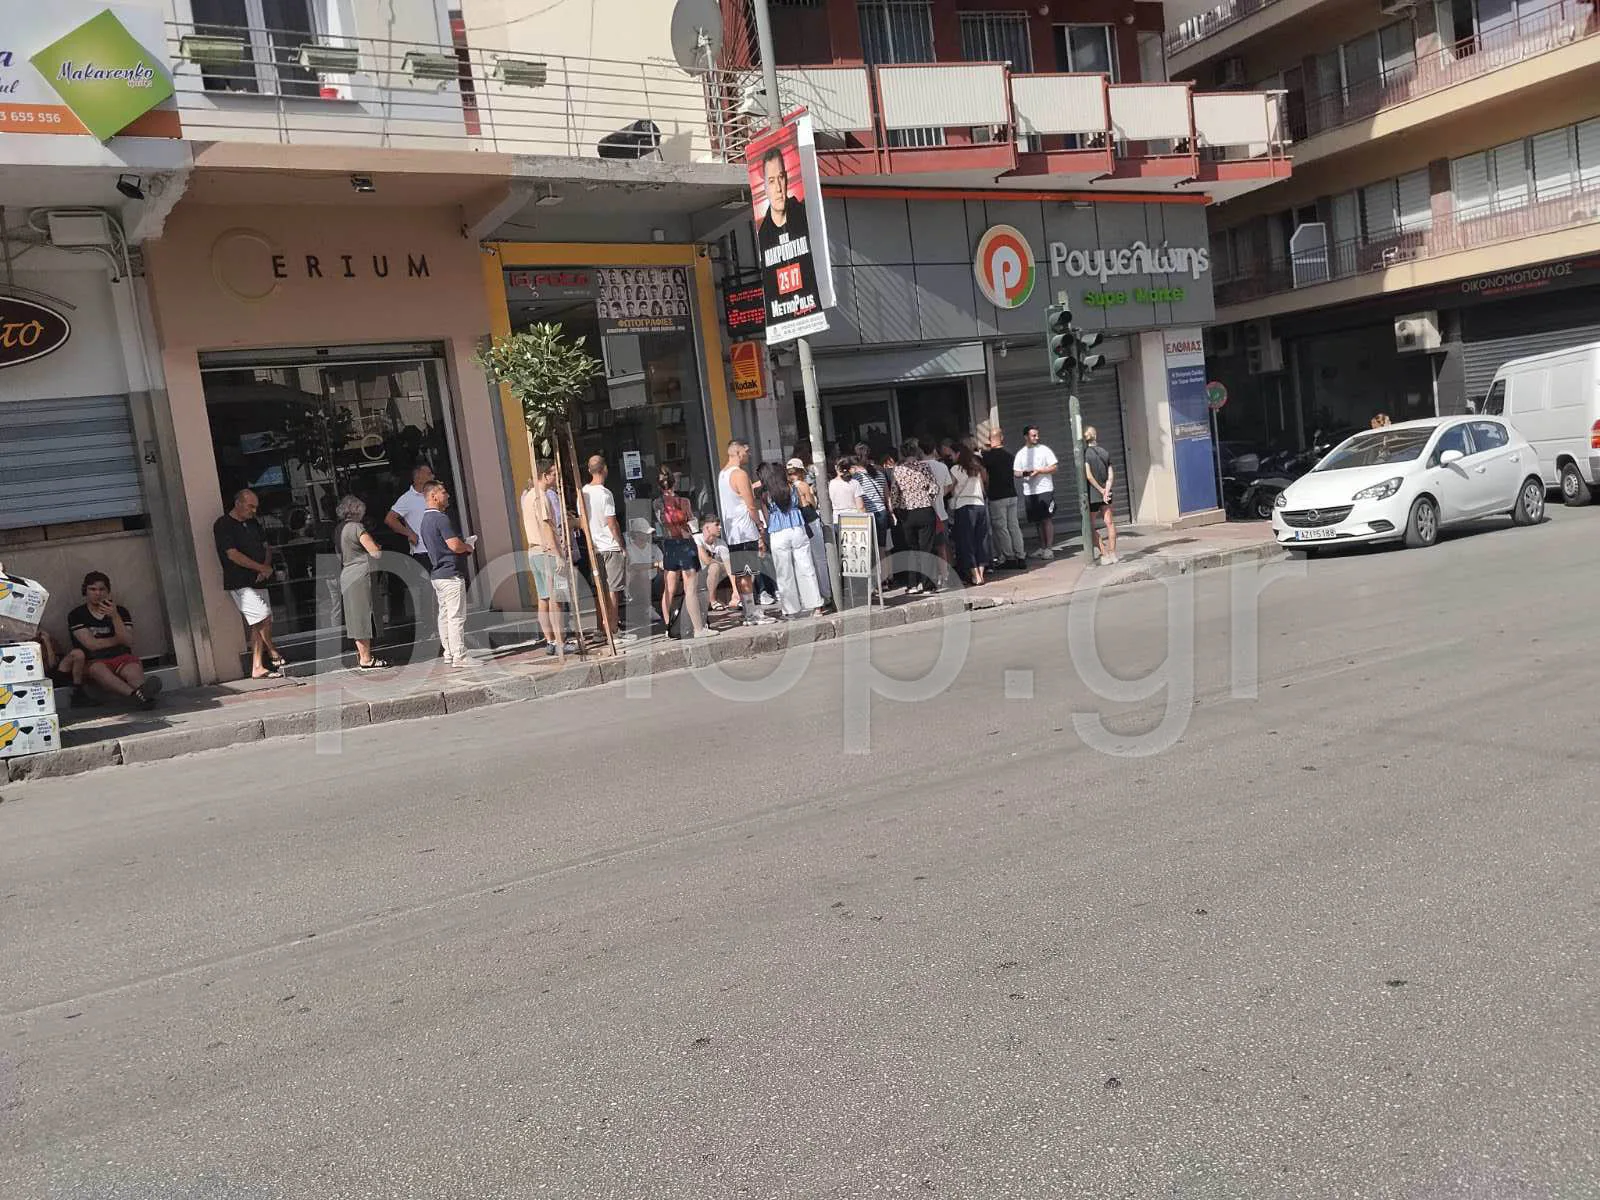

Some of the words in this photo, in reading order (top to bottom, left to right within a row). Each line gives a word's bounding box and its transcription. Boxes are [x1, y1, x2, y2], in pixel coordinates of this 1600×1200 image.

[57, 61, 155, 84] Makarenko
[1461, 262, 1573, 293] ΟΙΚΟΝΟΜΟΠΟΥΛΟΣ
[735, 379, 758, 390] Kodak
